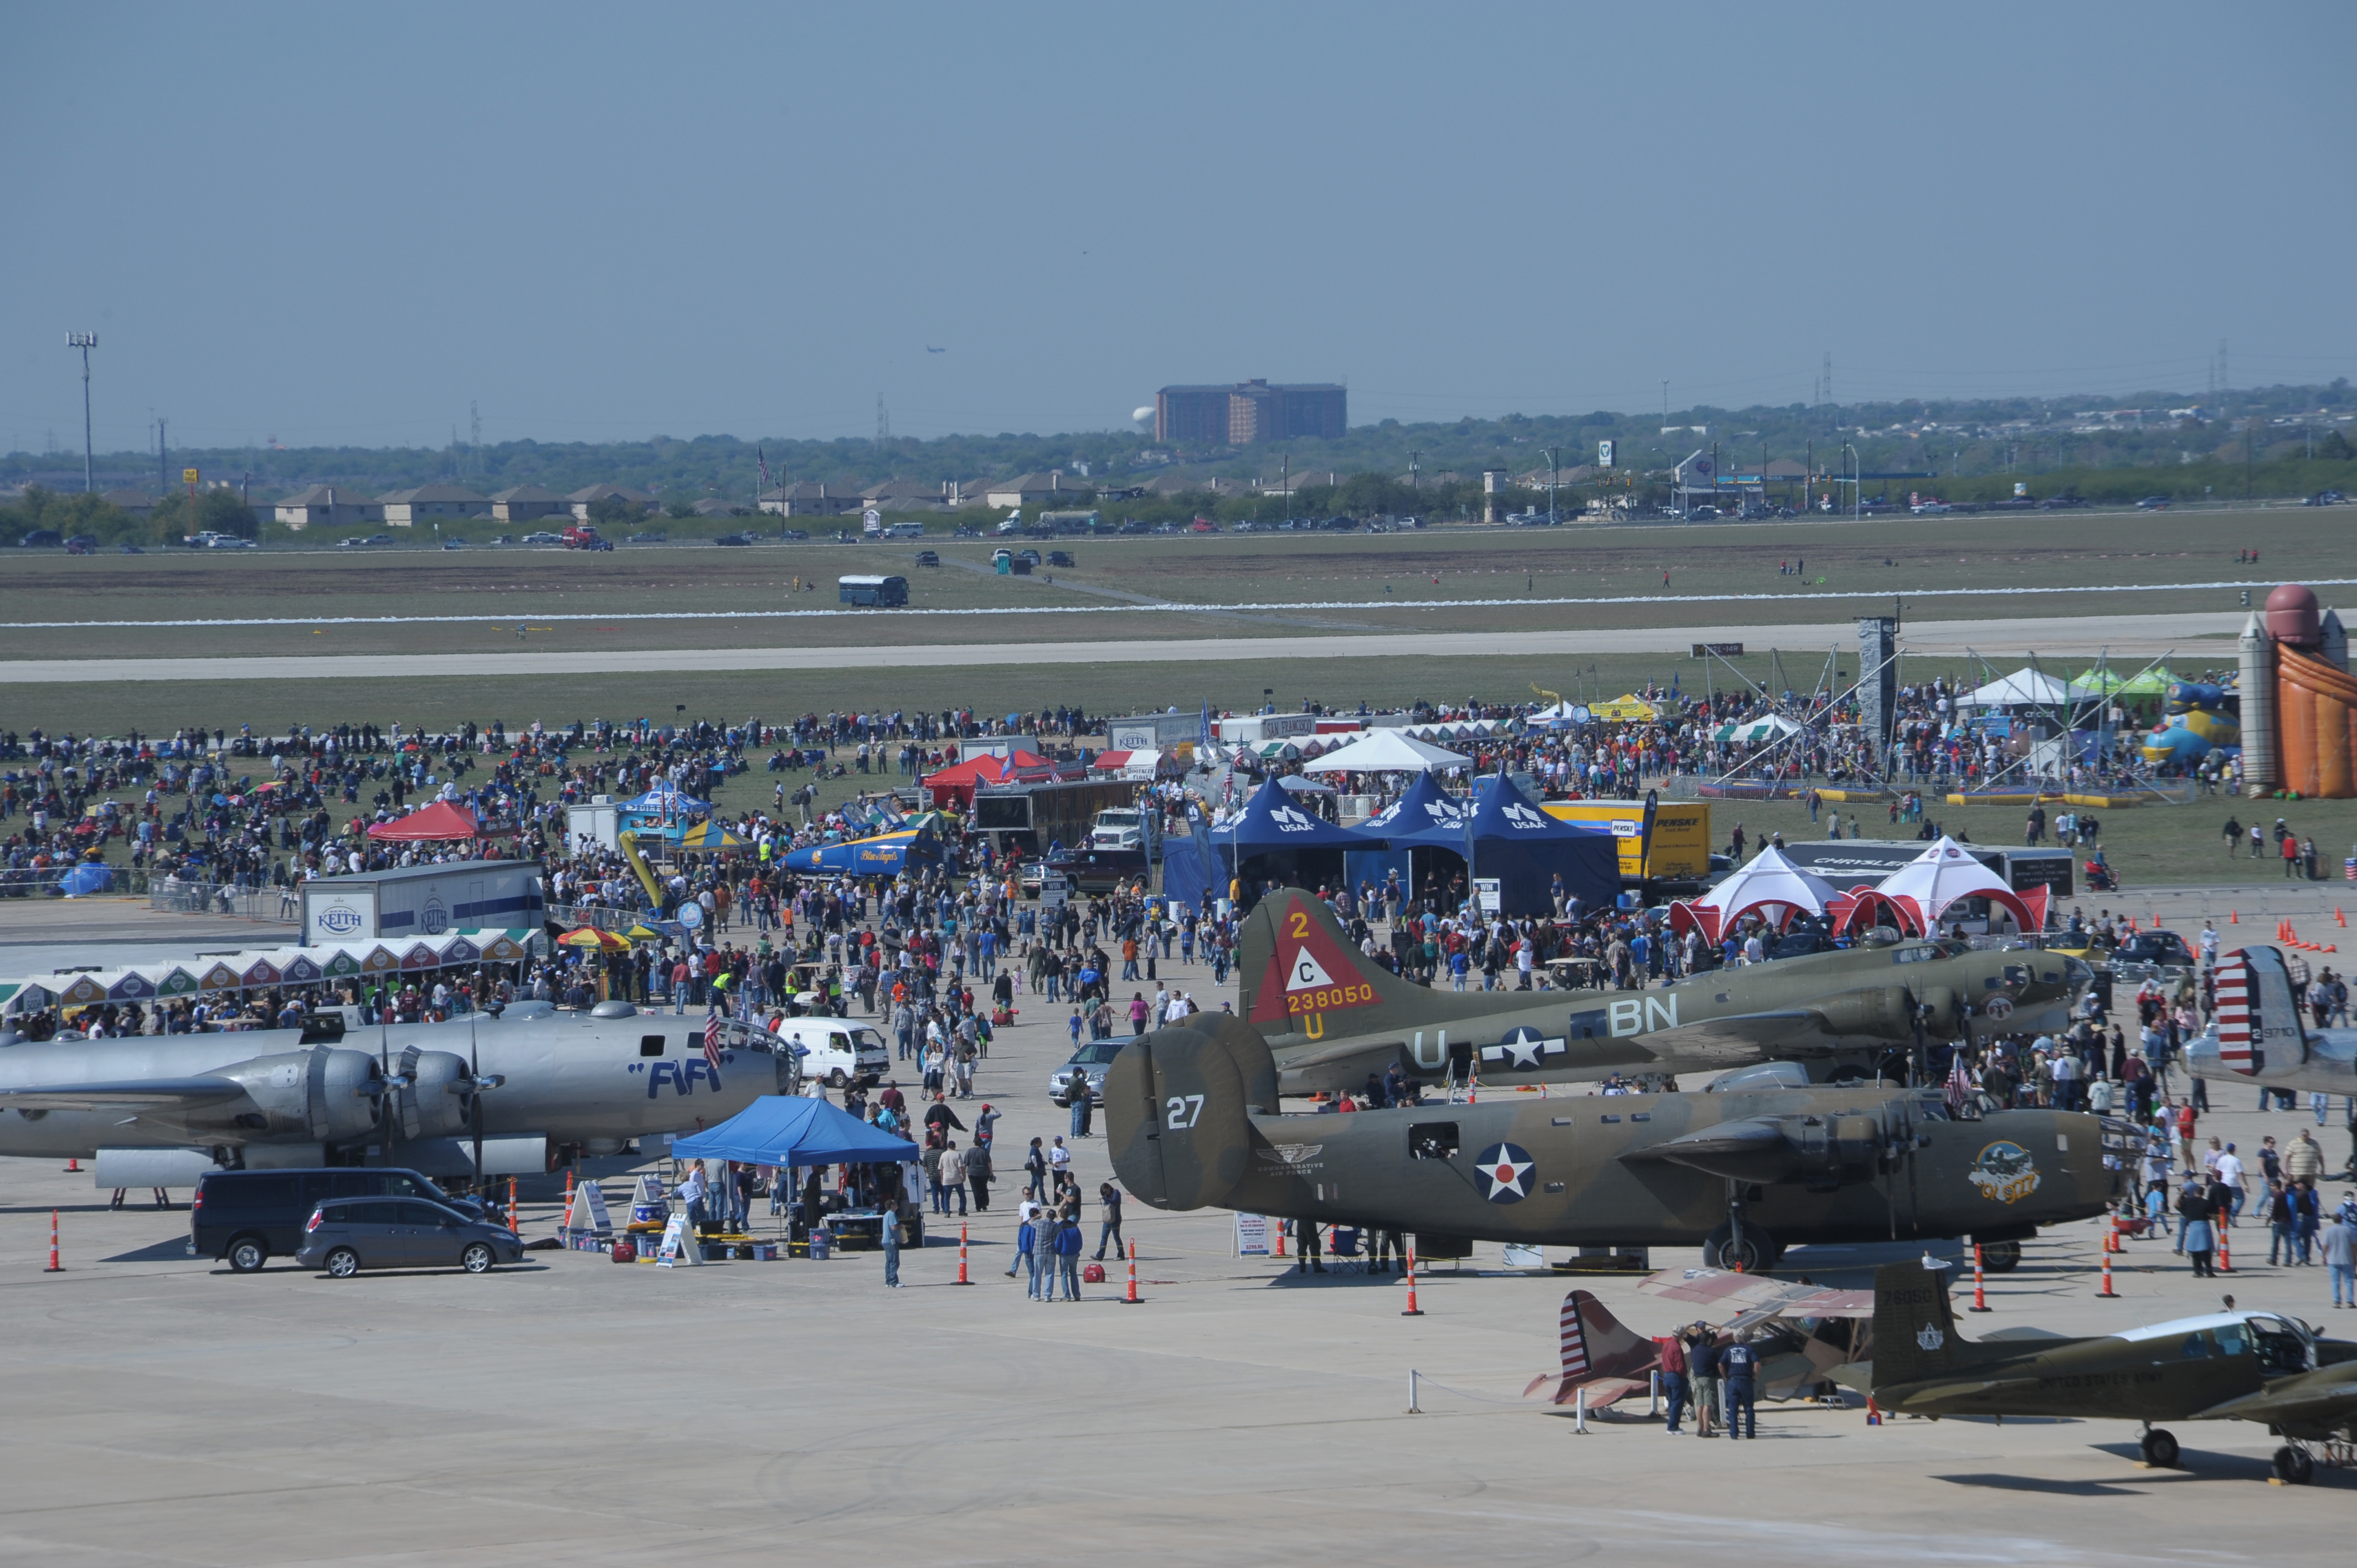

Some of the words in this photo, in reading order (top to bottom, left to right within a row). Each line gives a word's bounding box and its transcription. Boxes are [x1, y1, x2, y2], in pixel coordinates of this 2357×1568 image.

[1267, 722, 1279, 738] SAN
[1282, 719, 1312, 734] FRANCISCO
[1119, 737, 1147, 746] KEITH
[1279, 824, 1314, 832] USAA
[1655, 818, 1699, 827] PENSKE
[860, 850, 876, 860] Blue
[876, 850, 898, 864] Angels
[1814, 858, 1910, 866] CHRYSLER
[318, 914, 362, 927] KEITH
[420, 909, 447, 930] KEITH
[1290, 912, 1309, 938] 2
[1299, 962, 1314, 982] C
[27, 999, 42, 1010] SODA
[1288, 984, 1372, 1012] 238050
[1610, 993, 1678, 1038] BN
[1304, 1013, 1324, 1039] U
[1414, 1030, 1446, 1069] U
[1166, 1094, 1204, 1129] 27
[1258, 1163, 1324, 1172] COMMEMORATIVE
[2039, 1376, 2080, 1389] UNITED
[2085, 1373, 2127, 1386] STATES
[2134, 1371, 2163, 1383] ARMY
